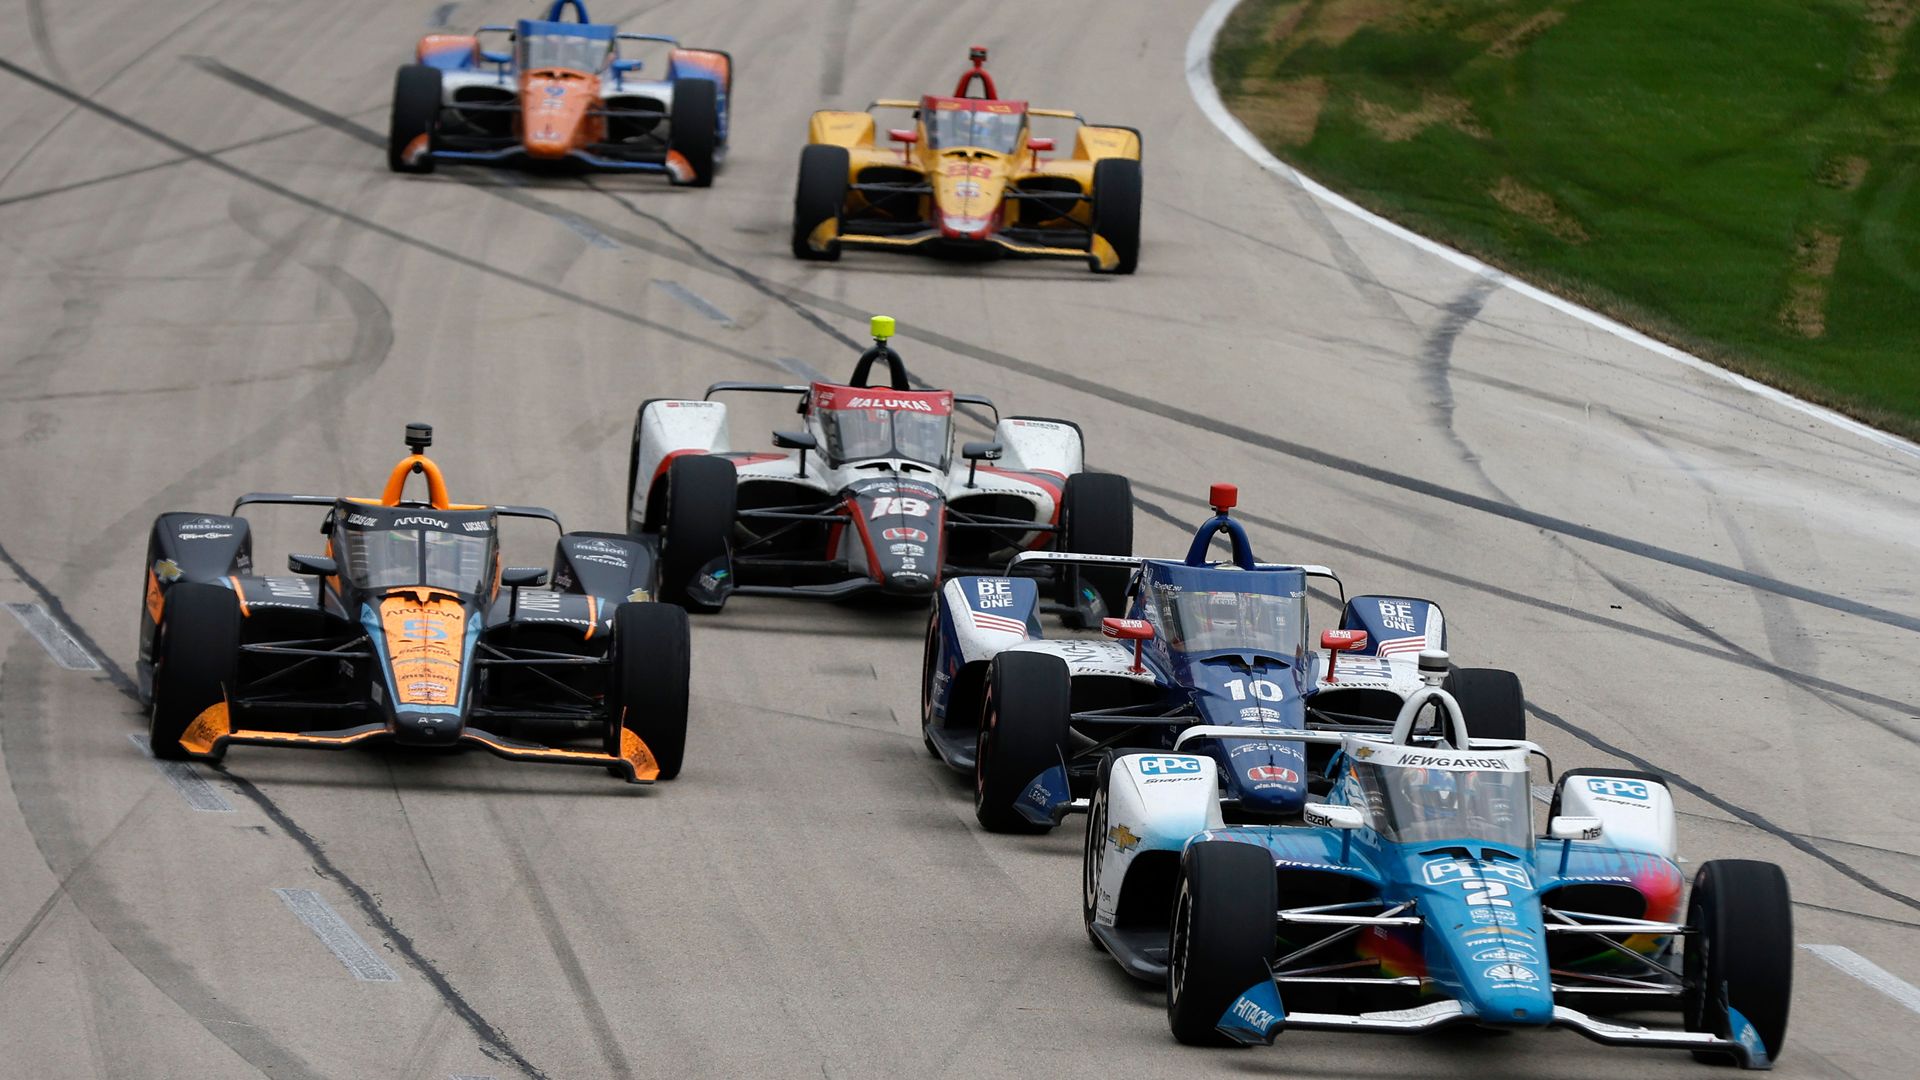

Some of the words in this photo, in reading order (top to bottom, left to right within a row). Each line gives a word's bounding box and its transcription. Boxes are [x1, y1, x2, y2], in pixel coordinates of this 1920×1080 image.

[847, 397, 932, 412] MALUKAS
[871, 496, 930, 520] 18
[348, 512, 366, 525] LUCAS
[394, 517, 448, 530] ARROW
[462, 521, 483, 532] LUCAS
[977, 582, 1013, 596] BE
[980, 599, 1014, 609] ONE
[1379, 603, 1413, 619] BE
[386, 608, 461, 620] ARROW
[403, 619, 448, 640] 5
[1383, 619, 1417, 633] ONE
[1223, 678, 1284, 703] 10
[1230, 744, 1305, 763] LEGION
[1141, 757, 1200, 774] PPG
[1397, 753, 1510, 771] NEWGARDEN
[1588, 780, 1648, 798] PPG
[1274, 858, 1363, 872] Firestone
[1429, 859, 1526, 884] PPG
[1462, 880, 1513, 908] 2
[1232, 996, 1275, 1032] HITACHI
